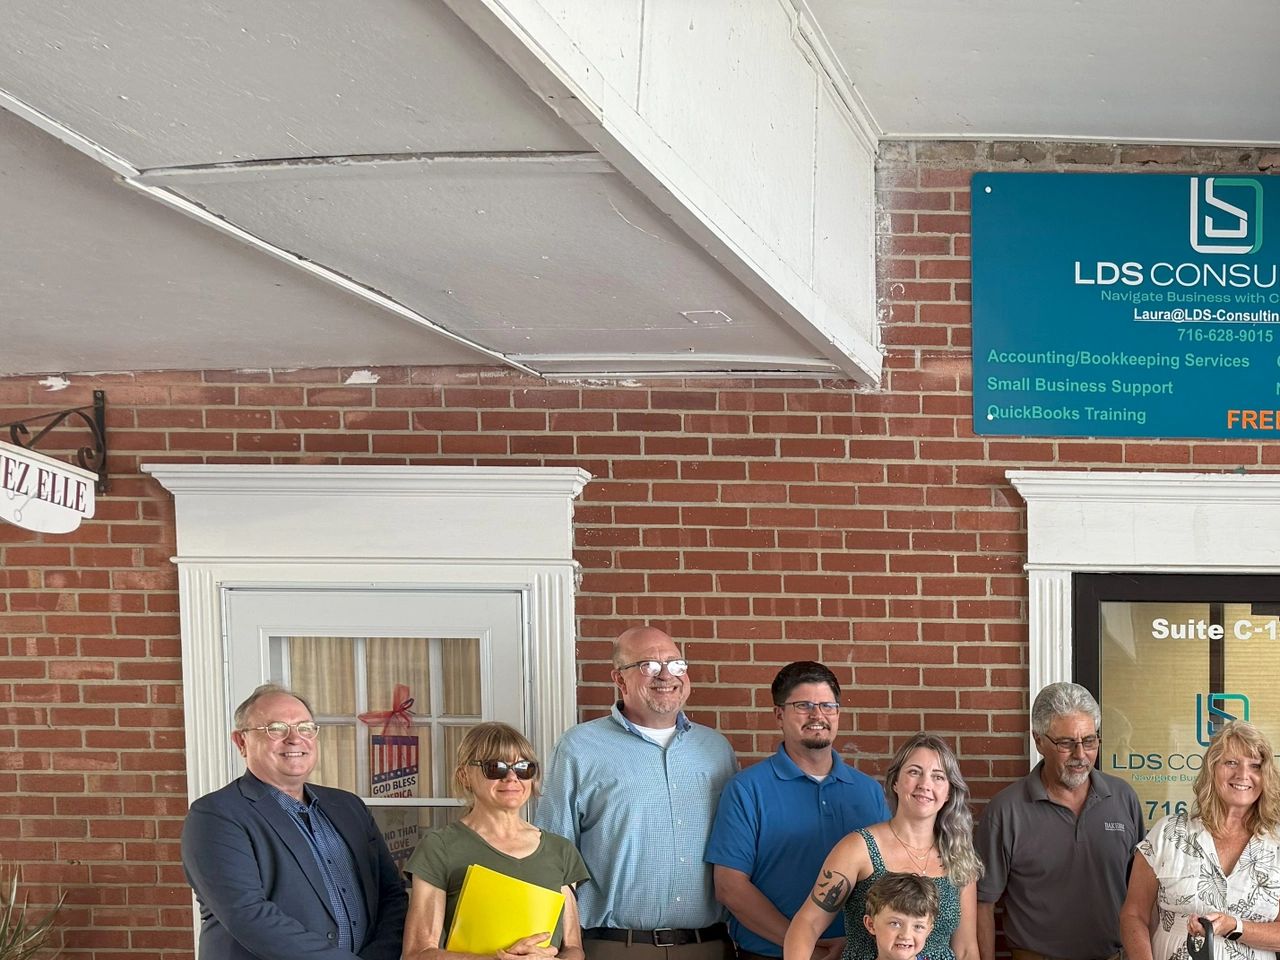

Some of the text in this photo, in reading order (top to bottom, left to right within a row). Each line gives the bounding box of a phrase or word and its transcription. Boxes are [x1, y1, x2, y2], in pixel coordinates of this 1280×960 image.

[1075, 262, 1144, 286] LDS
[1101, 290, 1163, 304] Navigate
[1167, 291, 1230, 303] Business
[1234, 292, 1265, 304] with
[1177, 329, 1274, 343] 716-628-9015
[987, 350, 1250, 369] Accounting/Bookkeeping Services
[987, 377, 1174, 396] Small Business Support
[987, 405, 1146, 425] QuickBooks Training
[0, 455, 87, 513] EZ ELLE
[1151, 618, 1225, 640] Suite
[1112, 753, 1163, 770] LDS
[373, 776, 416, 795] GOD BLESS
[397, 824, 418, 838] THAT
